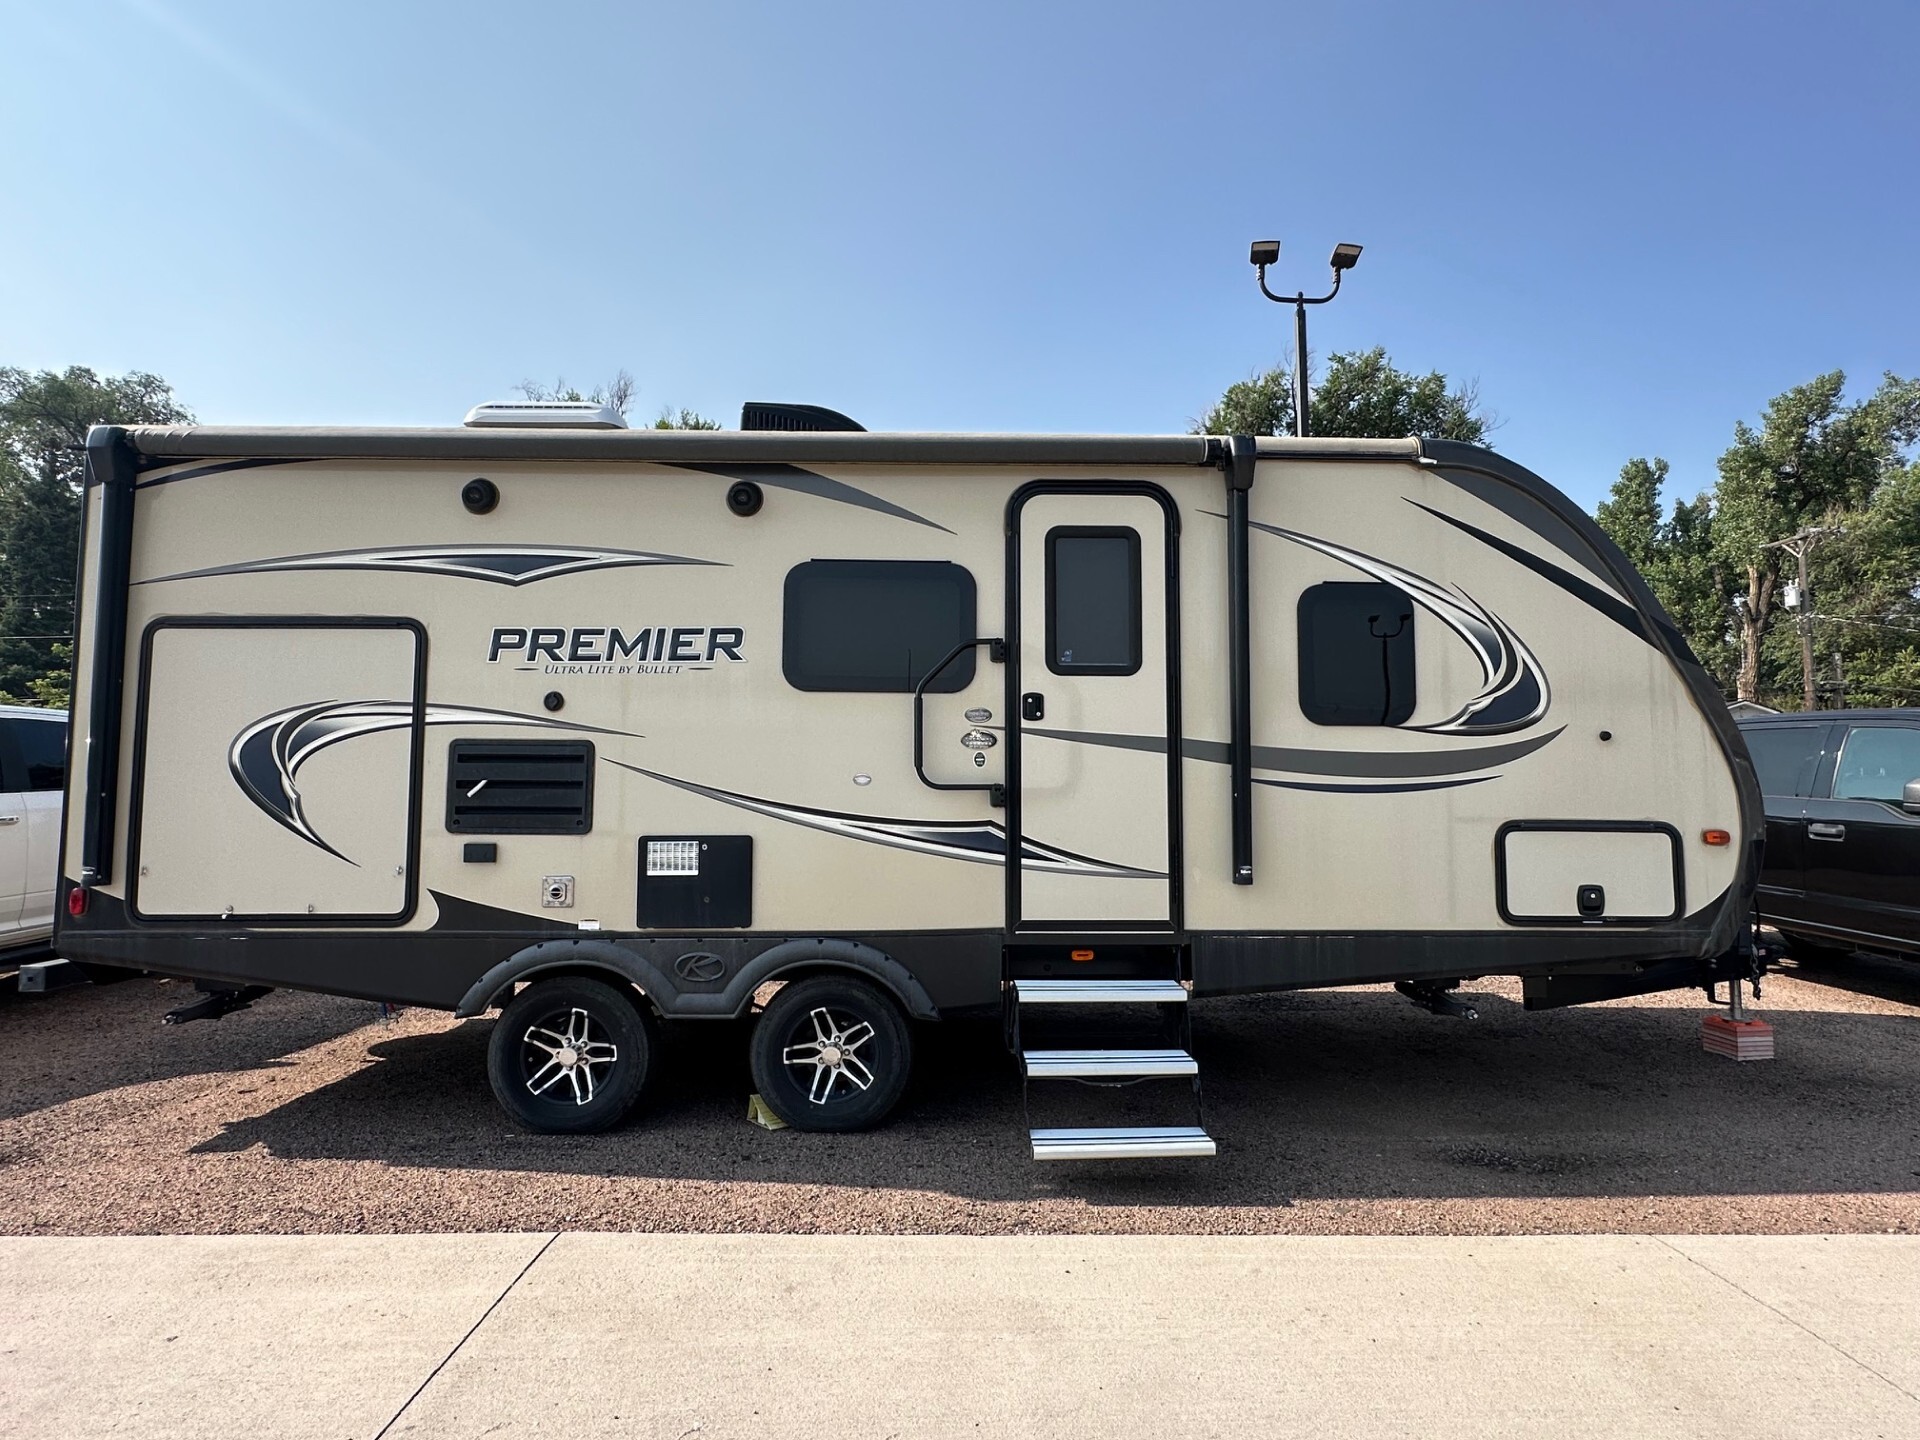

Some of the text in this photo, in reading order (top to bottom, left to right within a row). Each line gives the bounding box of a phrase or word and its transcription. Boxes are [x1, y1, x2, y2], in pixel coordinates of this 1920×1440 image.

[487, 627, 746, 663] PREMIER
[544, 664, 683, 675] ULTRA LITE BY BULLET
